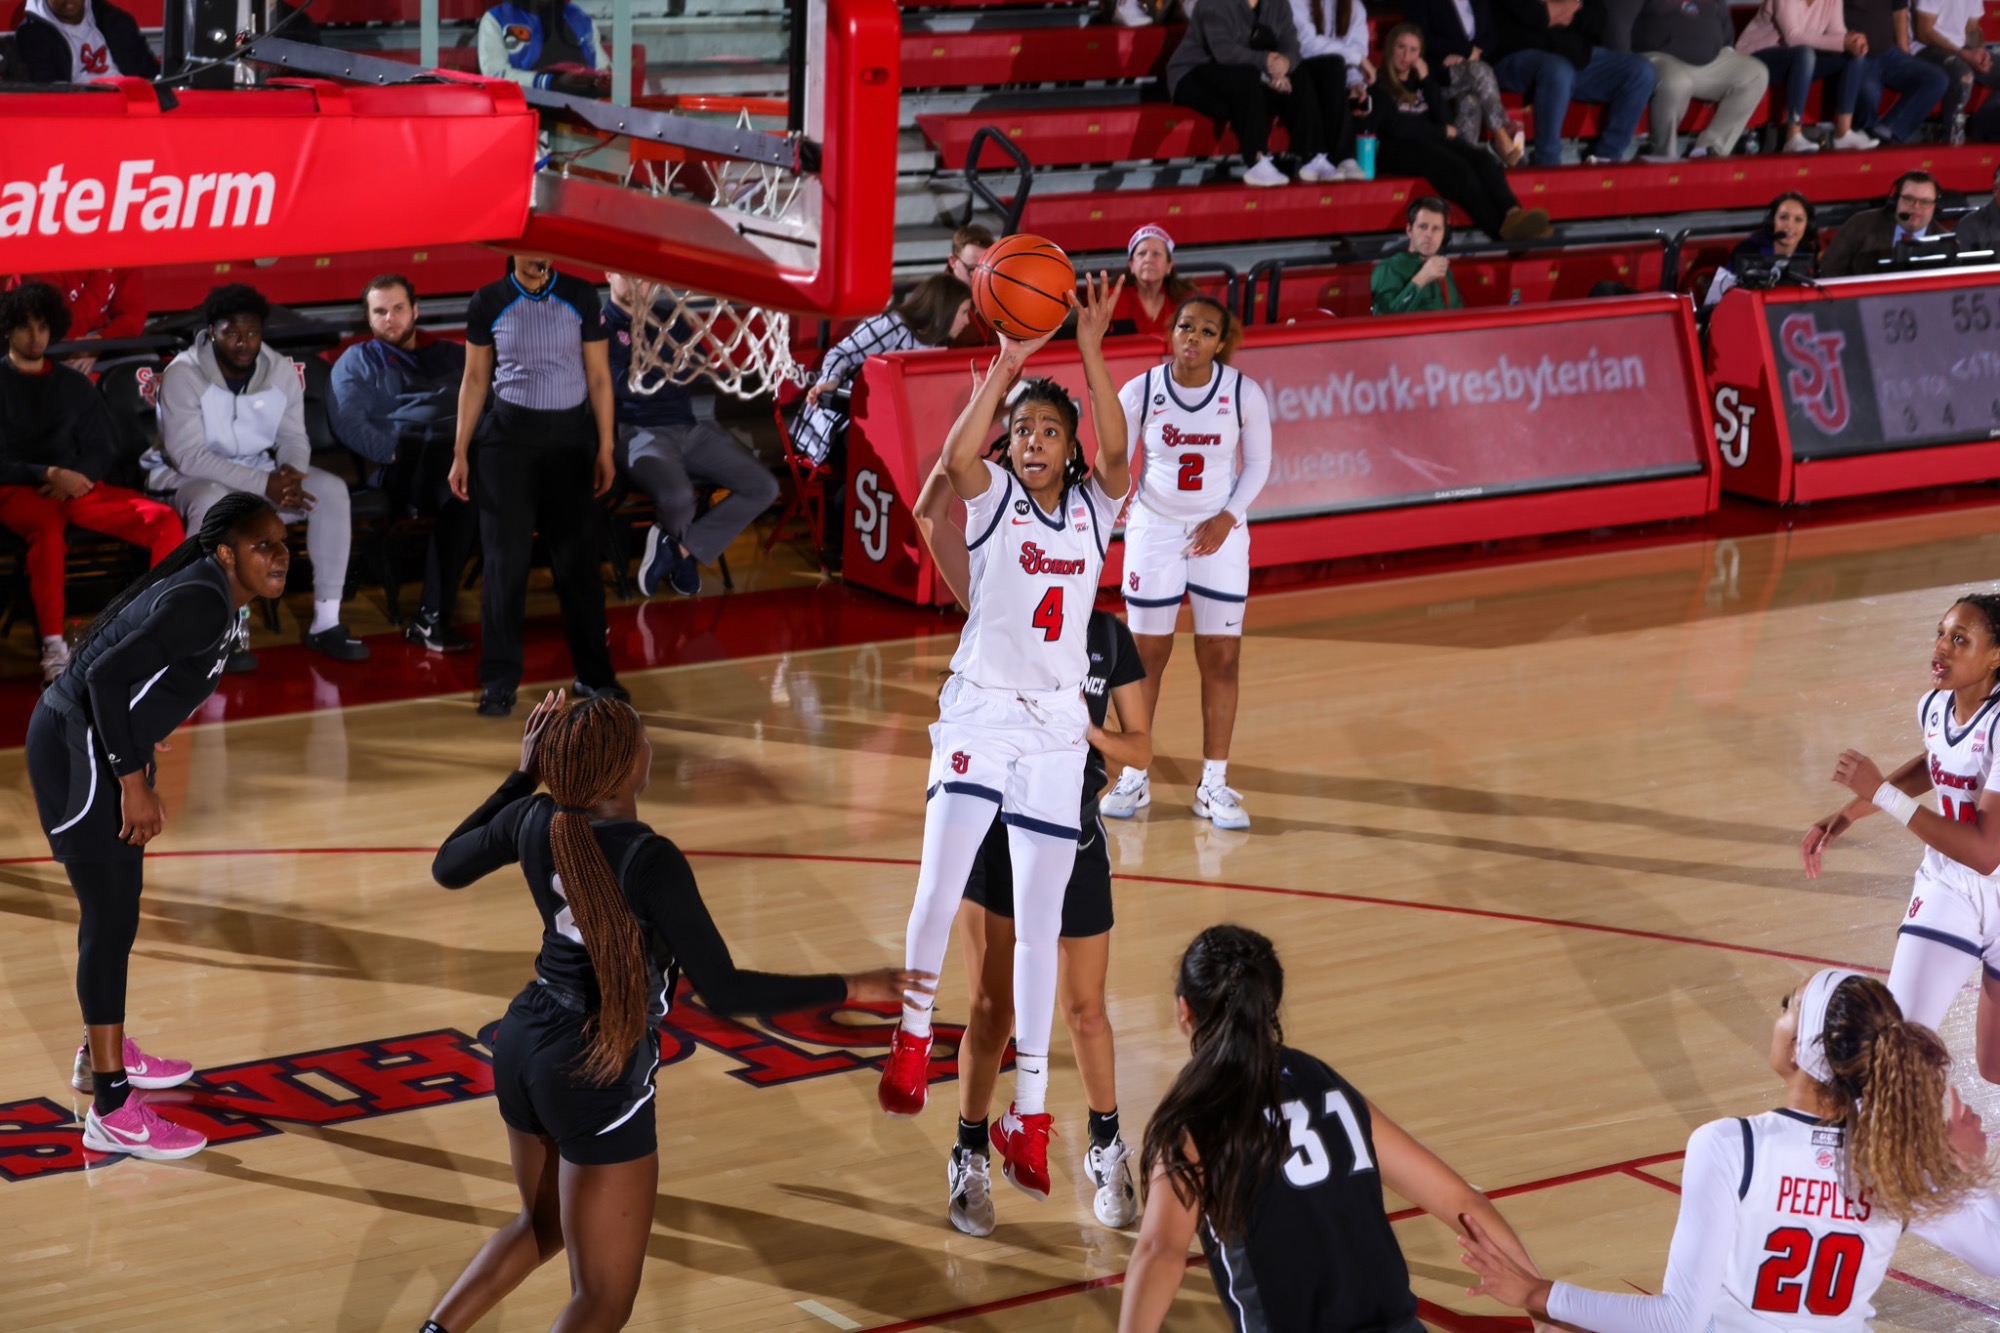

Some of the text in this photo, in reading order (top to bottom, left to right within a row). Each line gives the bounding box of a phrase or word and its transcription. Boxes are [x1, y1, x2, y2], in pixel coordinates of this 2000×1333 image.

[1178, 453, 1204, 491] 2
[1015, 500, 1030, 514] JK
[1032, 586, 1064, 642] 4
[1263, 1089, 1374, 1187] 31
[1776, 1175, 1873, 1223] PEEPLES
[1752, 1226, 1865, 1317] 20
